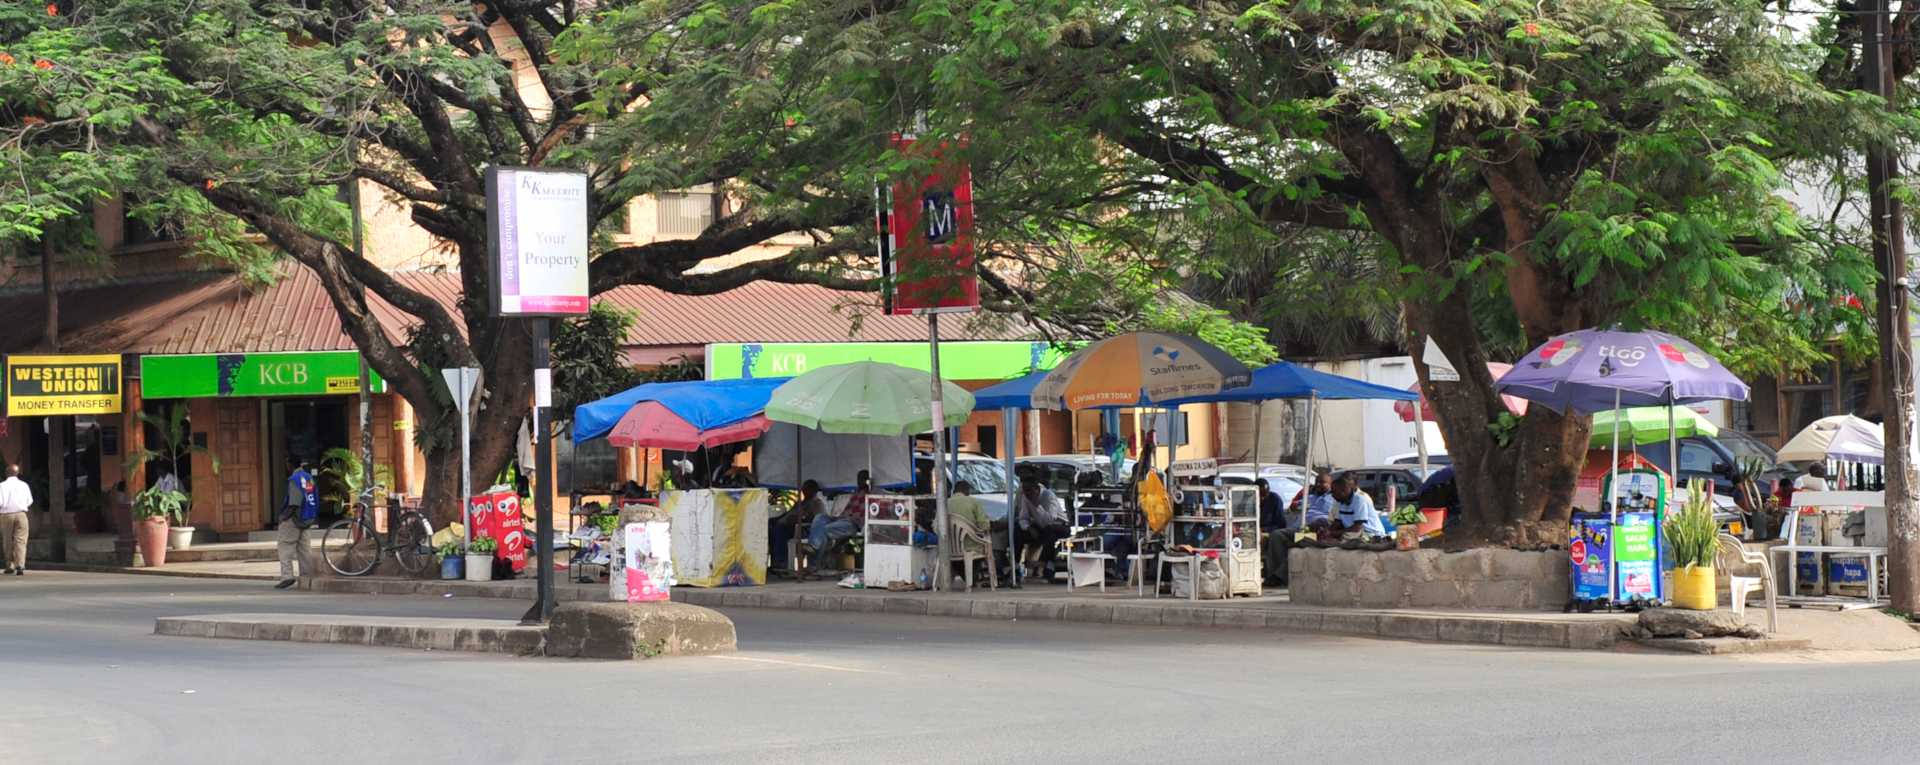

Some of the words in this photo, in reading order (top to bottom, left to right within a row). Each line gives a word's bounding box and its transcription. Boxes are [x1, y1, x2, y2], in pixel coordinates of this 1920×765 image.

[928, 199, 952, 237] M
[534, 232, 567, 245] Your
[524, 252, 581, 269] Property
[1598, 345, 1646, 361] tigo
[772, 352, 808, 374] KCB
[1149, 363, 1201, 376] StarTimes
[15, 366, 99, 381] WESTERN
[260, 363, 309, 385] KCB
[41, 379, 99, 393] UNION
[17, 400, 55, 410] MONEY
[58, 398, 113, 409] TRANSFER
